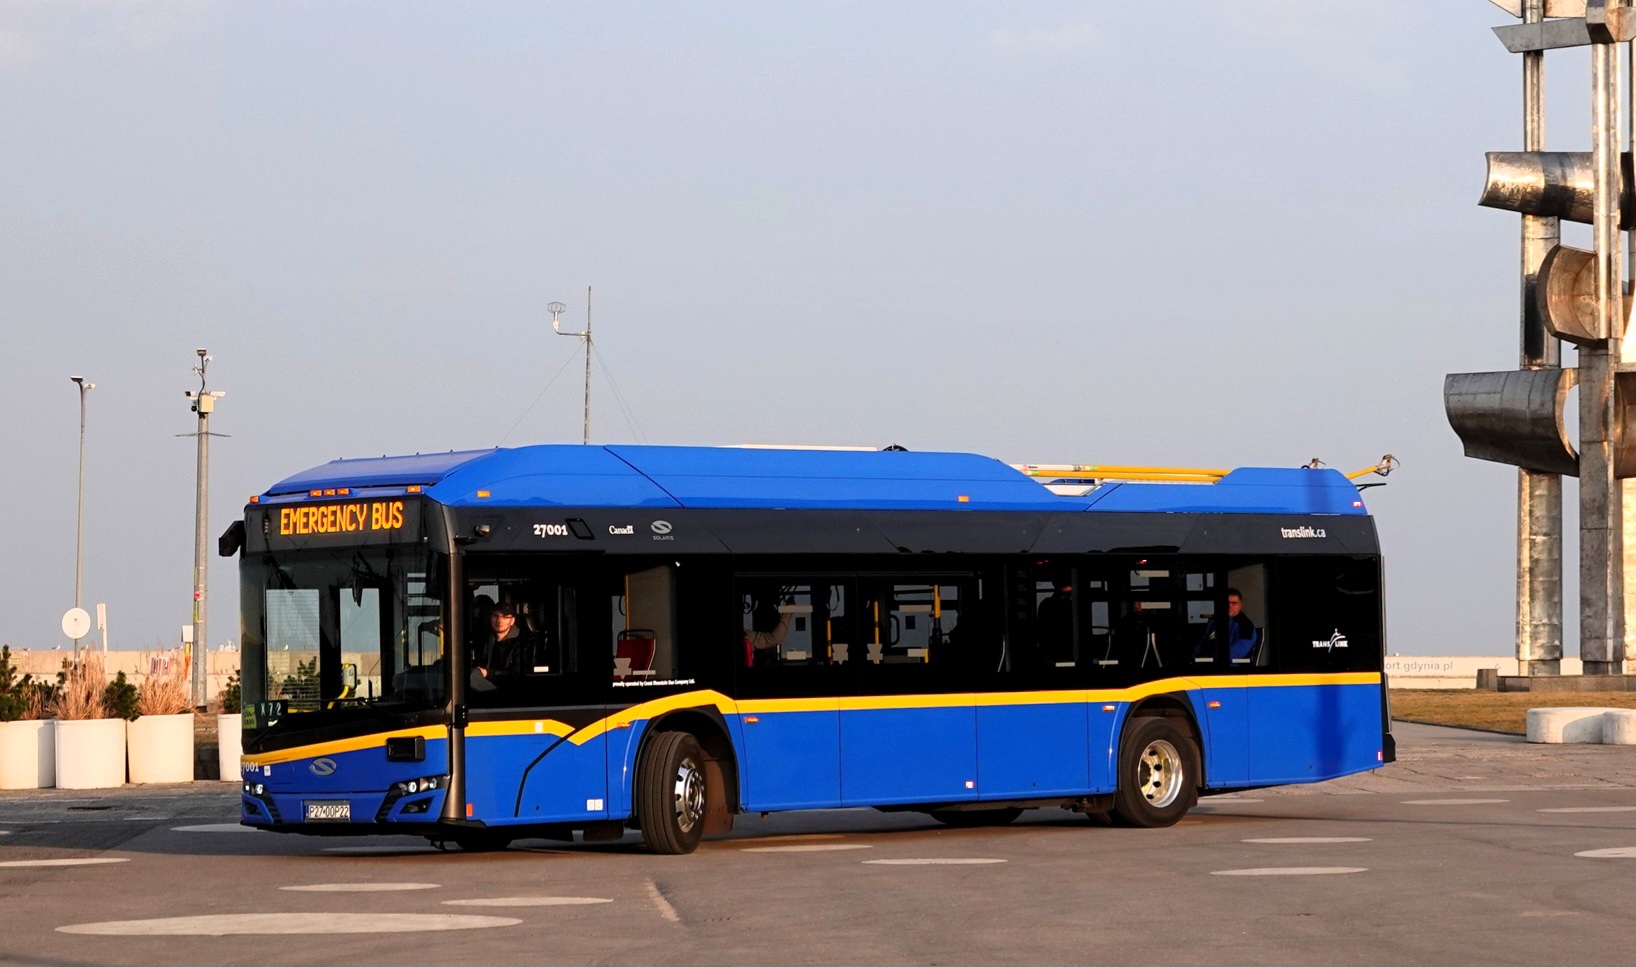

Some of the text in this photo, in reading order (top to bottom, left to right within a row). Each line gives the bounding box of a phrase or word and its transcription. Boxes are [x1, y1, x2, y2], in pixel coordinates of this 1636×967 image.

[280, 501, 404, 536] EMERGENCY BUS
[533, 523, 568, 538] 27001
[1280, 525, 1327, 539] translink.ca
[1385, 661, 1453, 672] ort.gdynia.pl
